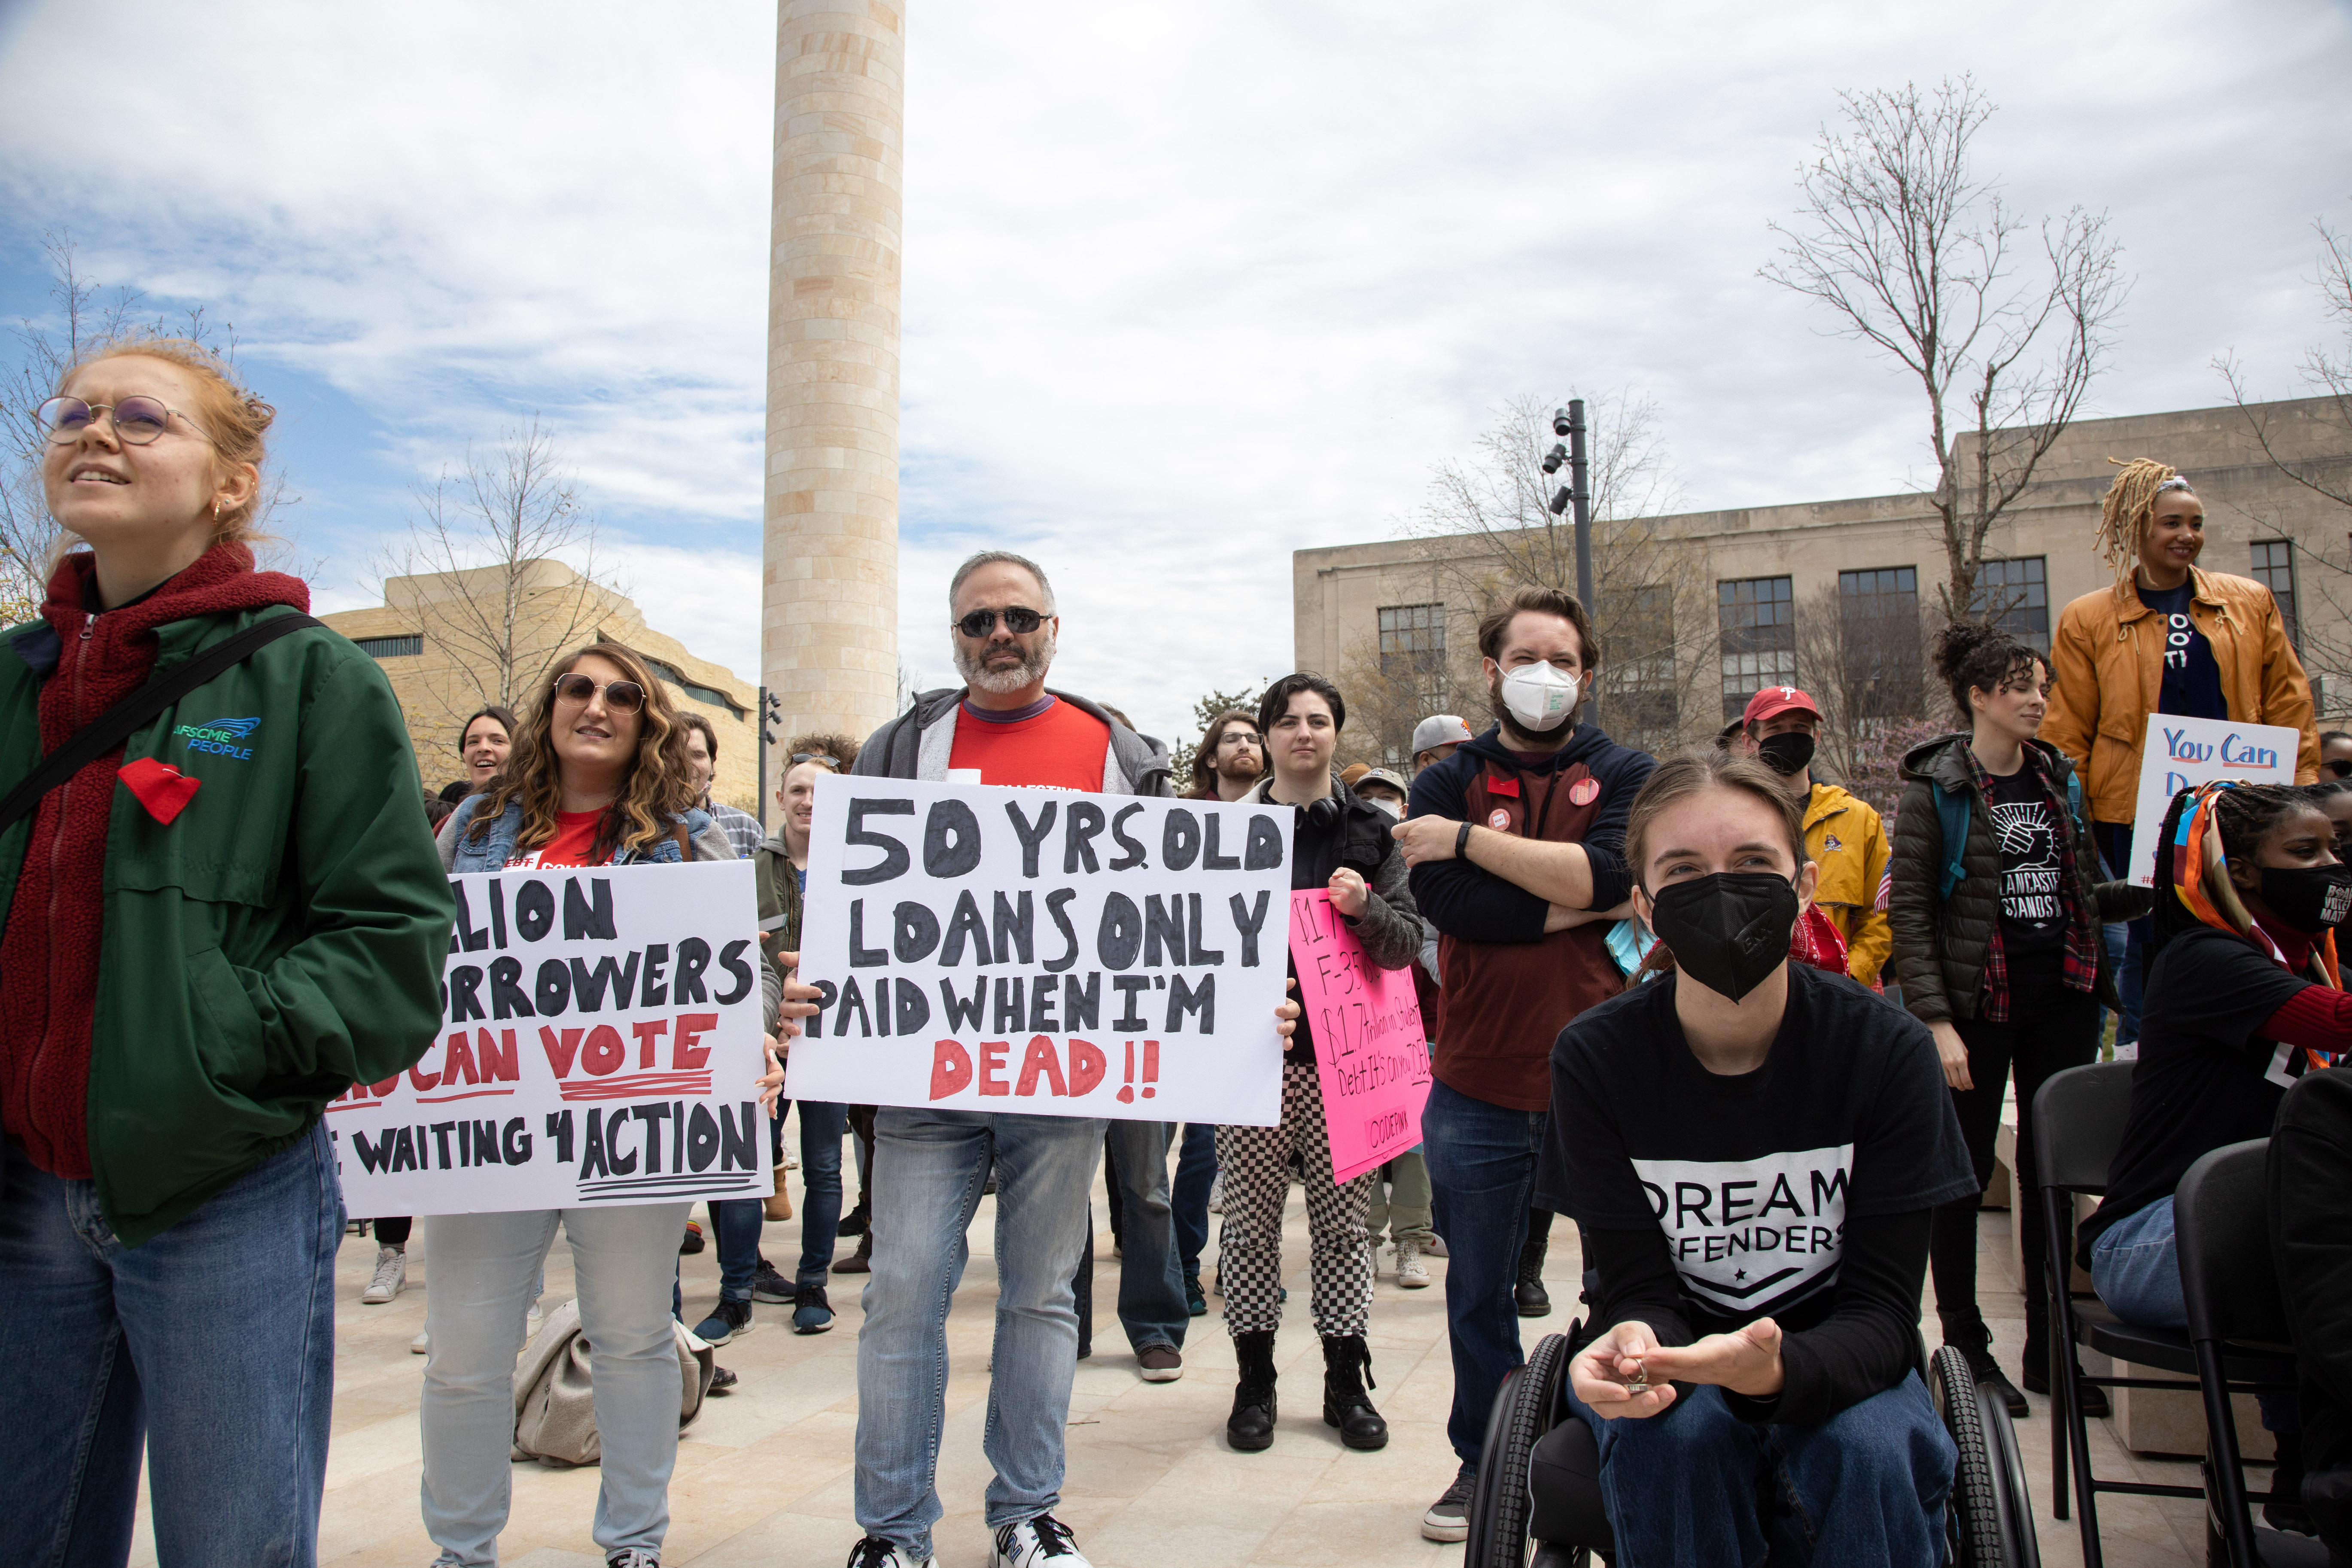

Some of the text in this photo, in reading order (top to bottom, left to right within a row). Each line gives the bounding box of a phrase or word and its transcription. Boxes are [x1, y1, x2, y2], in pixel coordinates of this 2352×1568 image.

[186, 739, 253, 760] PEOPLE
[2163, 727, 2277, 768] You Can
[503, 858, 533, 868] EBT
[841, 798, 981, 886] 50
[1162, 807, 1283, 871] OLD
[849, 887, 1271, 972] LOANS ONLY
[2001, 895, 2053, 918] STANDS
[442, 937, 753, 1023] RROWERS
[805, 971, 1216, 1038] PAID WHEN I'M
[538, 1013, 718, 1079] VOTE
[1321, 1003, 1363, 1068] $1.7
[1387, 1008, 1397, 1030] in
[352, 1117, 532, 1175] WAITING
[546, 1109, 574, 1163] 4
[578, 1100, 758, 1180] ACTION
[1370, 1110, 1408, 1148] CODEPINK
[1640, 1168, 1849, 1229] DREAM
